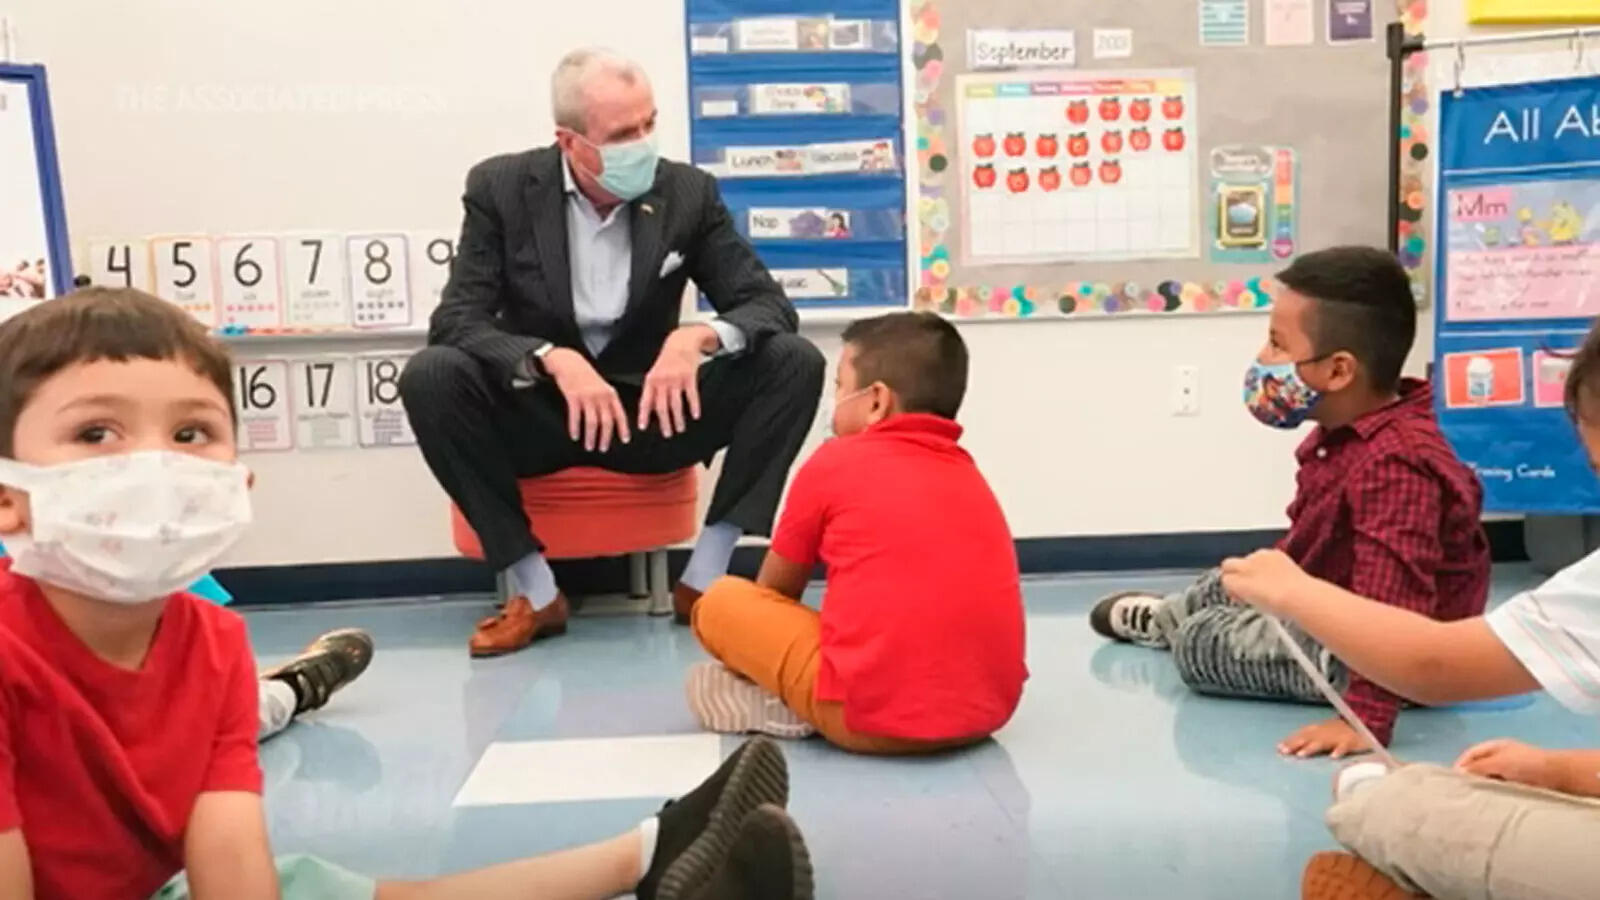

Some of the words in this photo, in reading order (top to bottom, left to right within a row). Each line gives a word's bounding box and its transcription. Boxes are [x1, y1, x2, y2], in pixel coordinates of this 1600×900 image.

[978, 42, 1072, 65] September
[1483, 107, 1540, 146] All
[732, 154, 774, 169] Lunch
[753, 216, 779, 230] Nap
[1456, 193, 1508, 218] Mm
[108, 244, 132, 288] 4
[173, 241, 197, 288] 5
[233, 242, 263, 288] 6
[300, 239, 324, 285] 7
[364, 239, 392, 285] 8
[239, 365, 277, 411] 16
[306, 363, 335, 408] 17
[367, 360, 401, 405] 18
